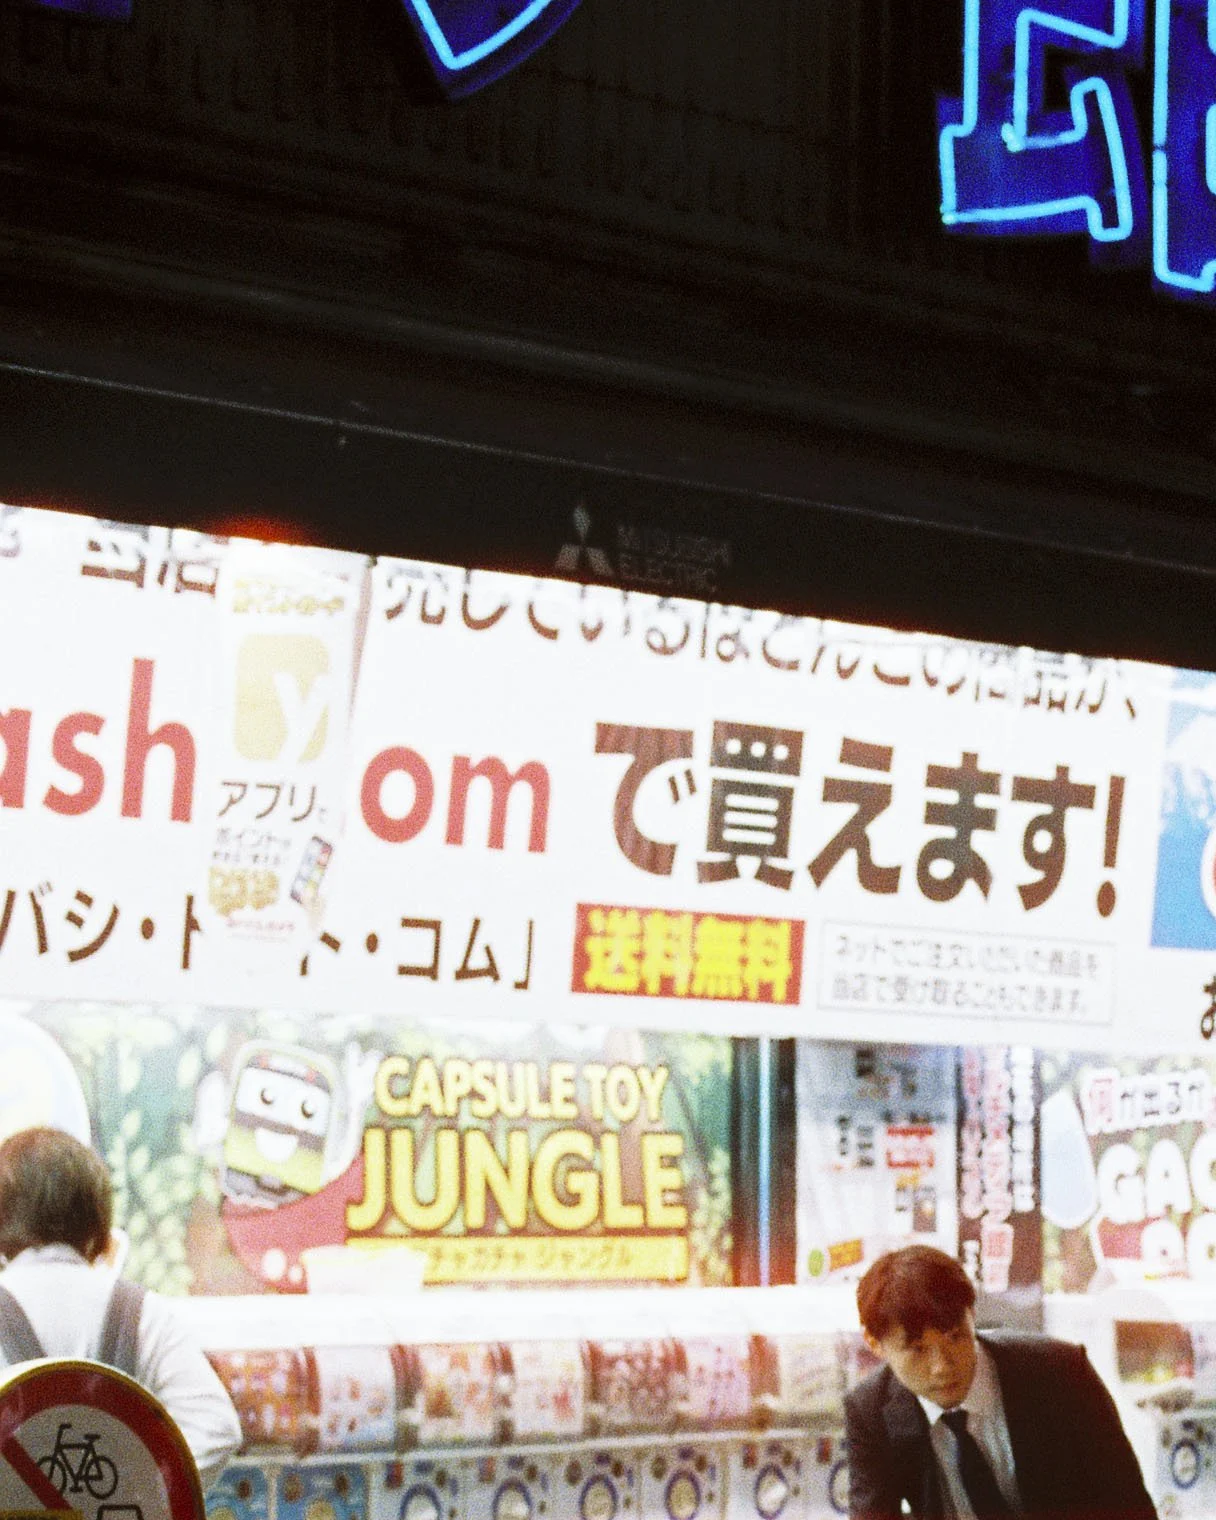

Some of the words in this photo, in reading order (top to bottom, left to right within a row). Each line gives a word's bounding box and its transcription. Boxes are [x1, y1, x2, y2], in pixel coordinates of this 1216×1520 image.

[594, 719, 1126, 919] で買えます!
[583, 909, 794, 1003] 送料無料
[375, 1056, 577, 1120] CAPSULE
[583, 1062, 670, 1123] TOY
[346, 1127, 689, 1232] JUNGLE
